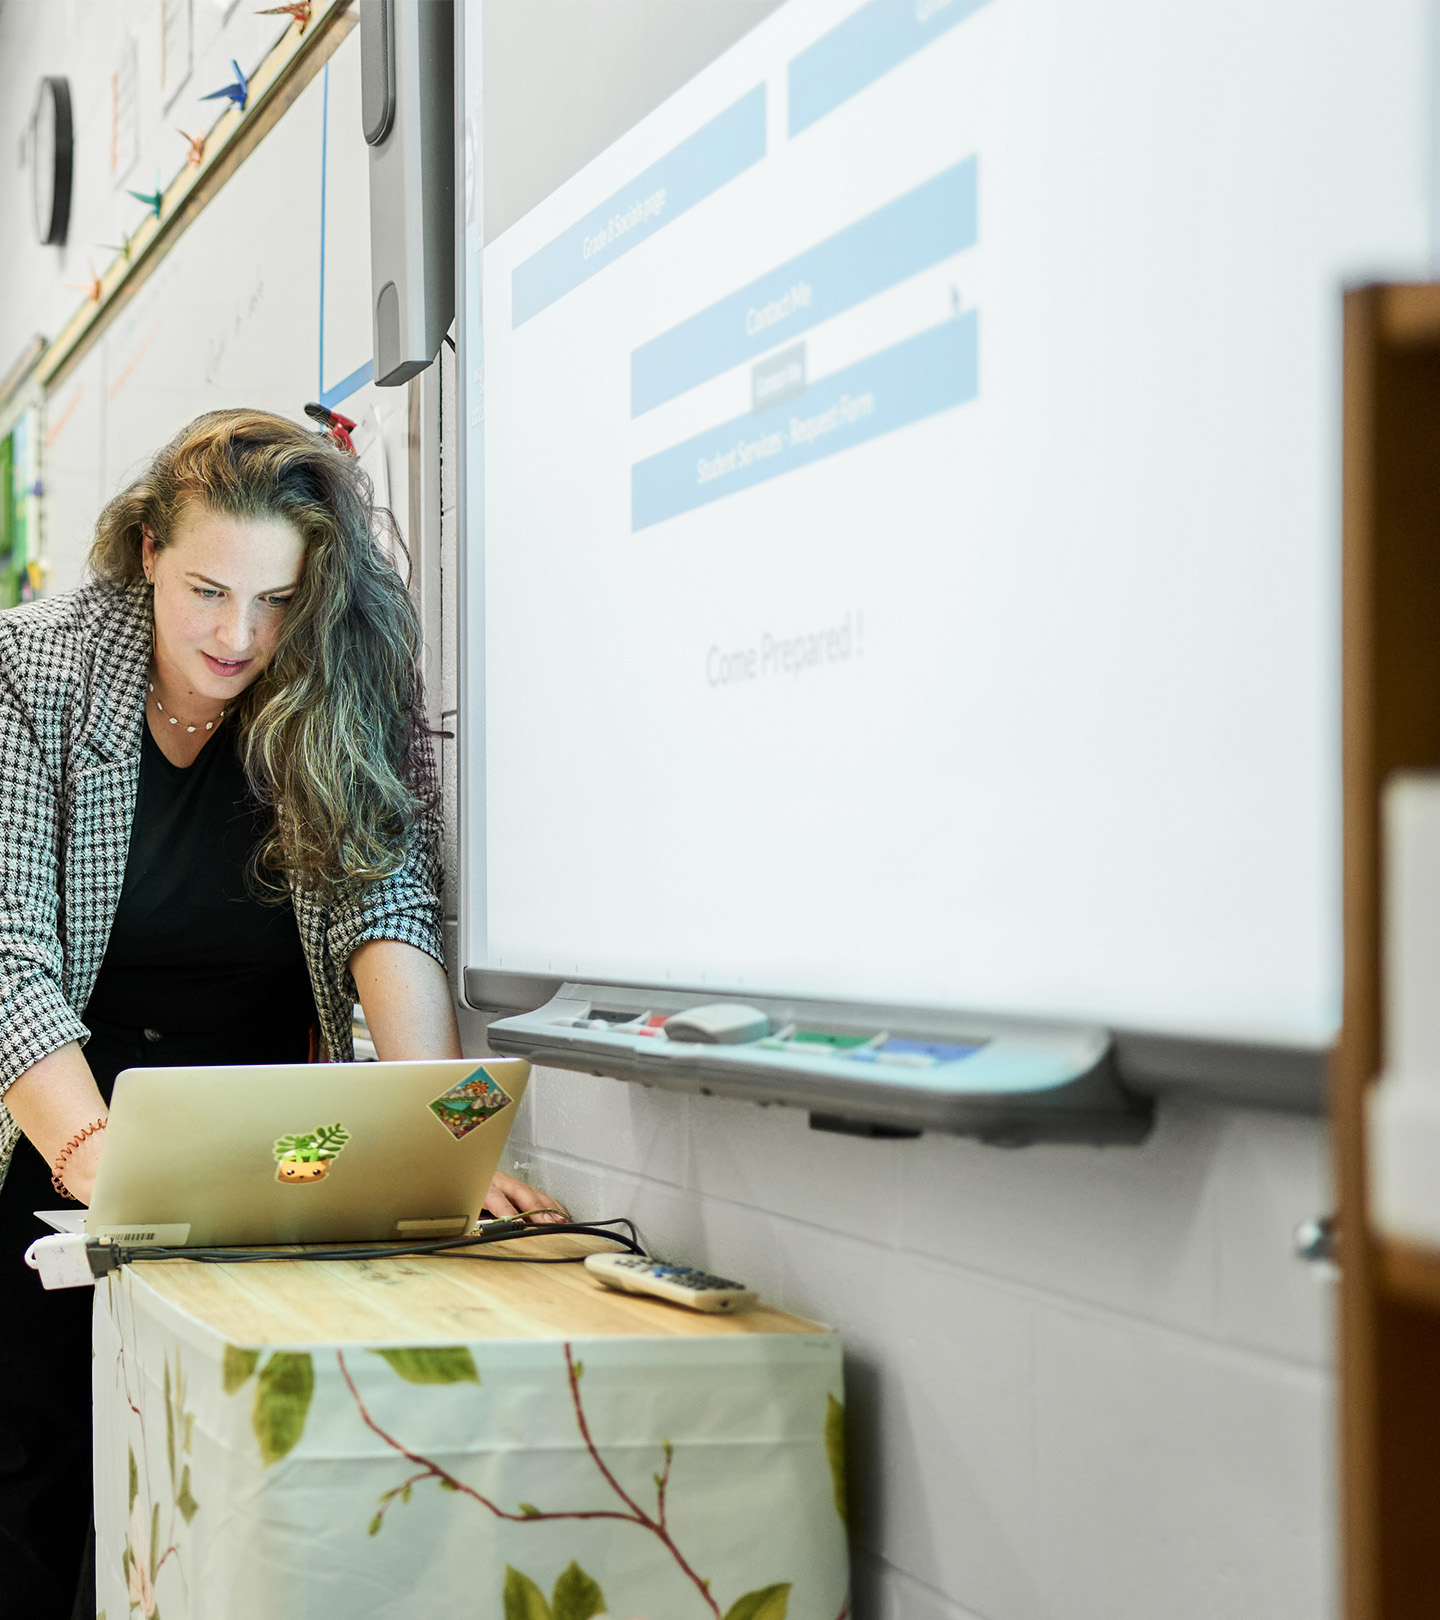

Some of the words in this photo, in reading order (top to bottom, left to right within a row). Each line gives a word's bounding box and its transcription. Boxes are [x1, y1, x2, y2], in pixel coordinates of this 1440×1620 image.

[583, 227, 607, 260] Grade
[607, 219, 615, 243] 8
[615, 200, 644, 238] Socials
[644, 188, 666, 224] page
[746, 291, 790, 336] Contact
[790, 282, 812, 312] Me
[697, 447, 737, 485] Student
[737, 431, 784, 468] Services
[789, 405, 838, 445] Request
[839, 391, 875, 423] Form
[706, 646, 758, 688] Come
[760, 610, 852, 682] Prepared
